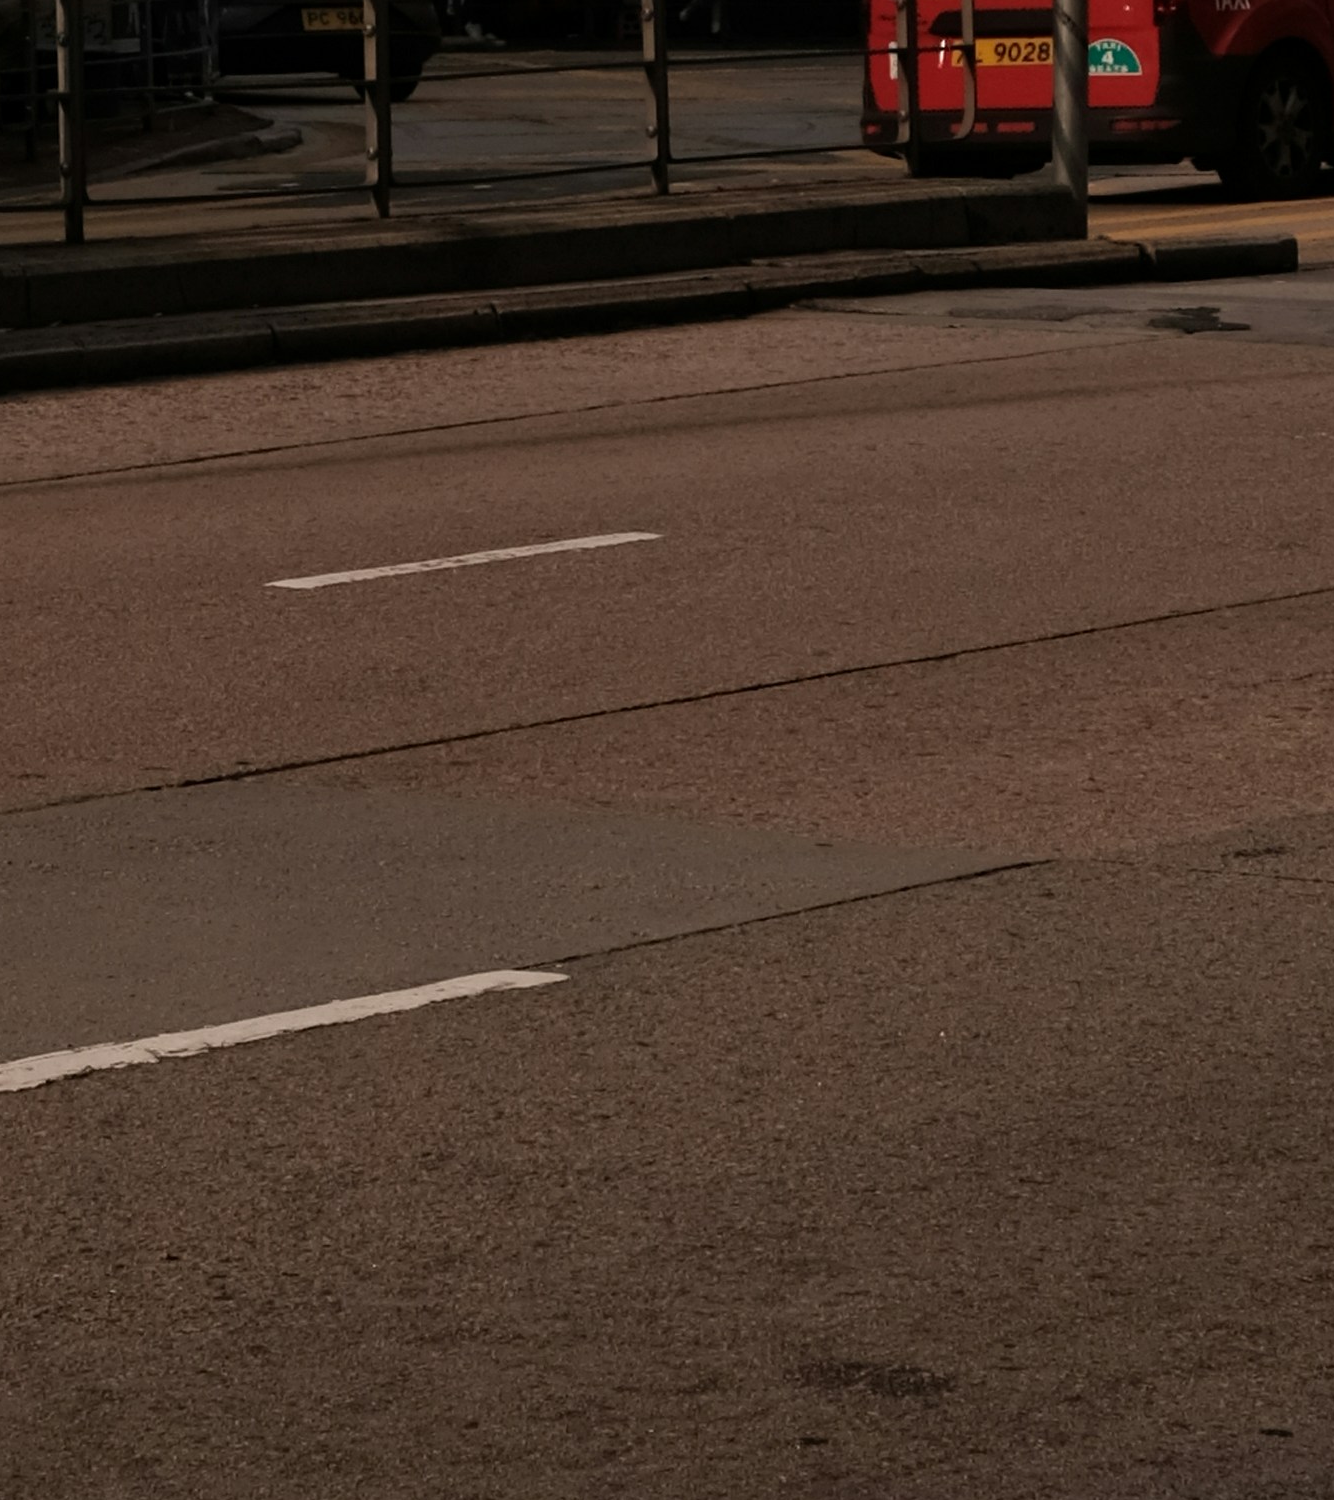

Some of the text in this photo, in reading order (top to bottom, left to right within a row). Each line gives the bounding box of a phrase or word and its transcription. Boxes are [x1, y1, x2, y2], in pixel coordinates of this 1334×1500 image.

[307, 11, 330, 27] PC
[994, 42, 1051, 63] 9028
[1100, 50, 1114, 65] 4
